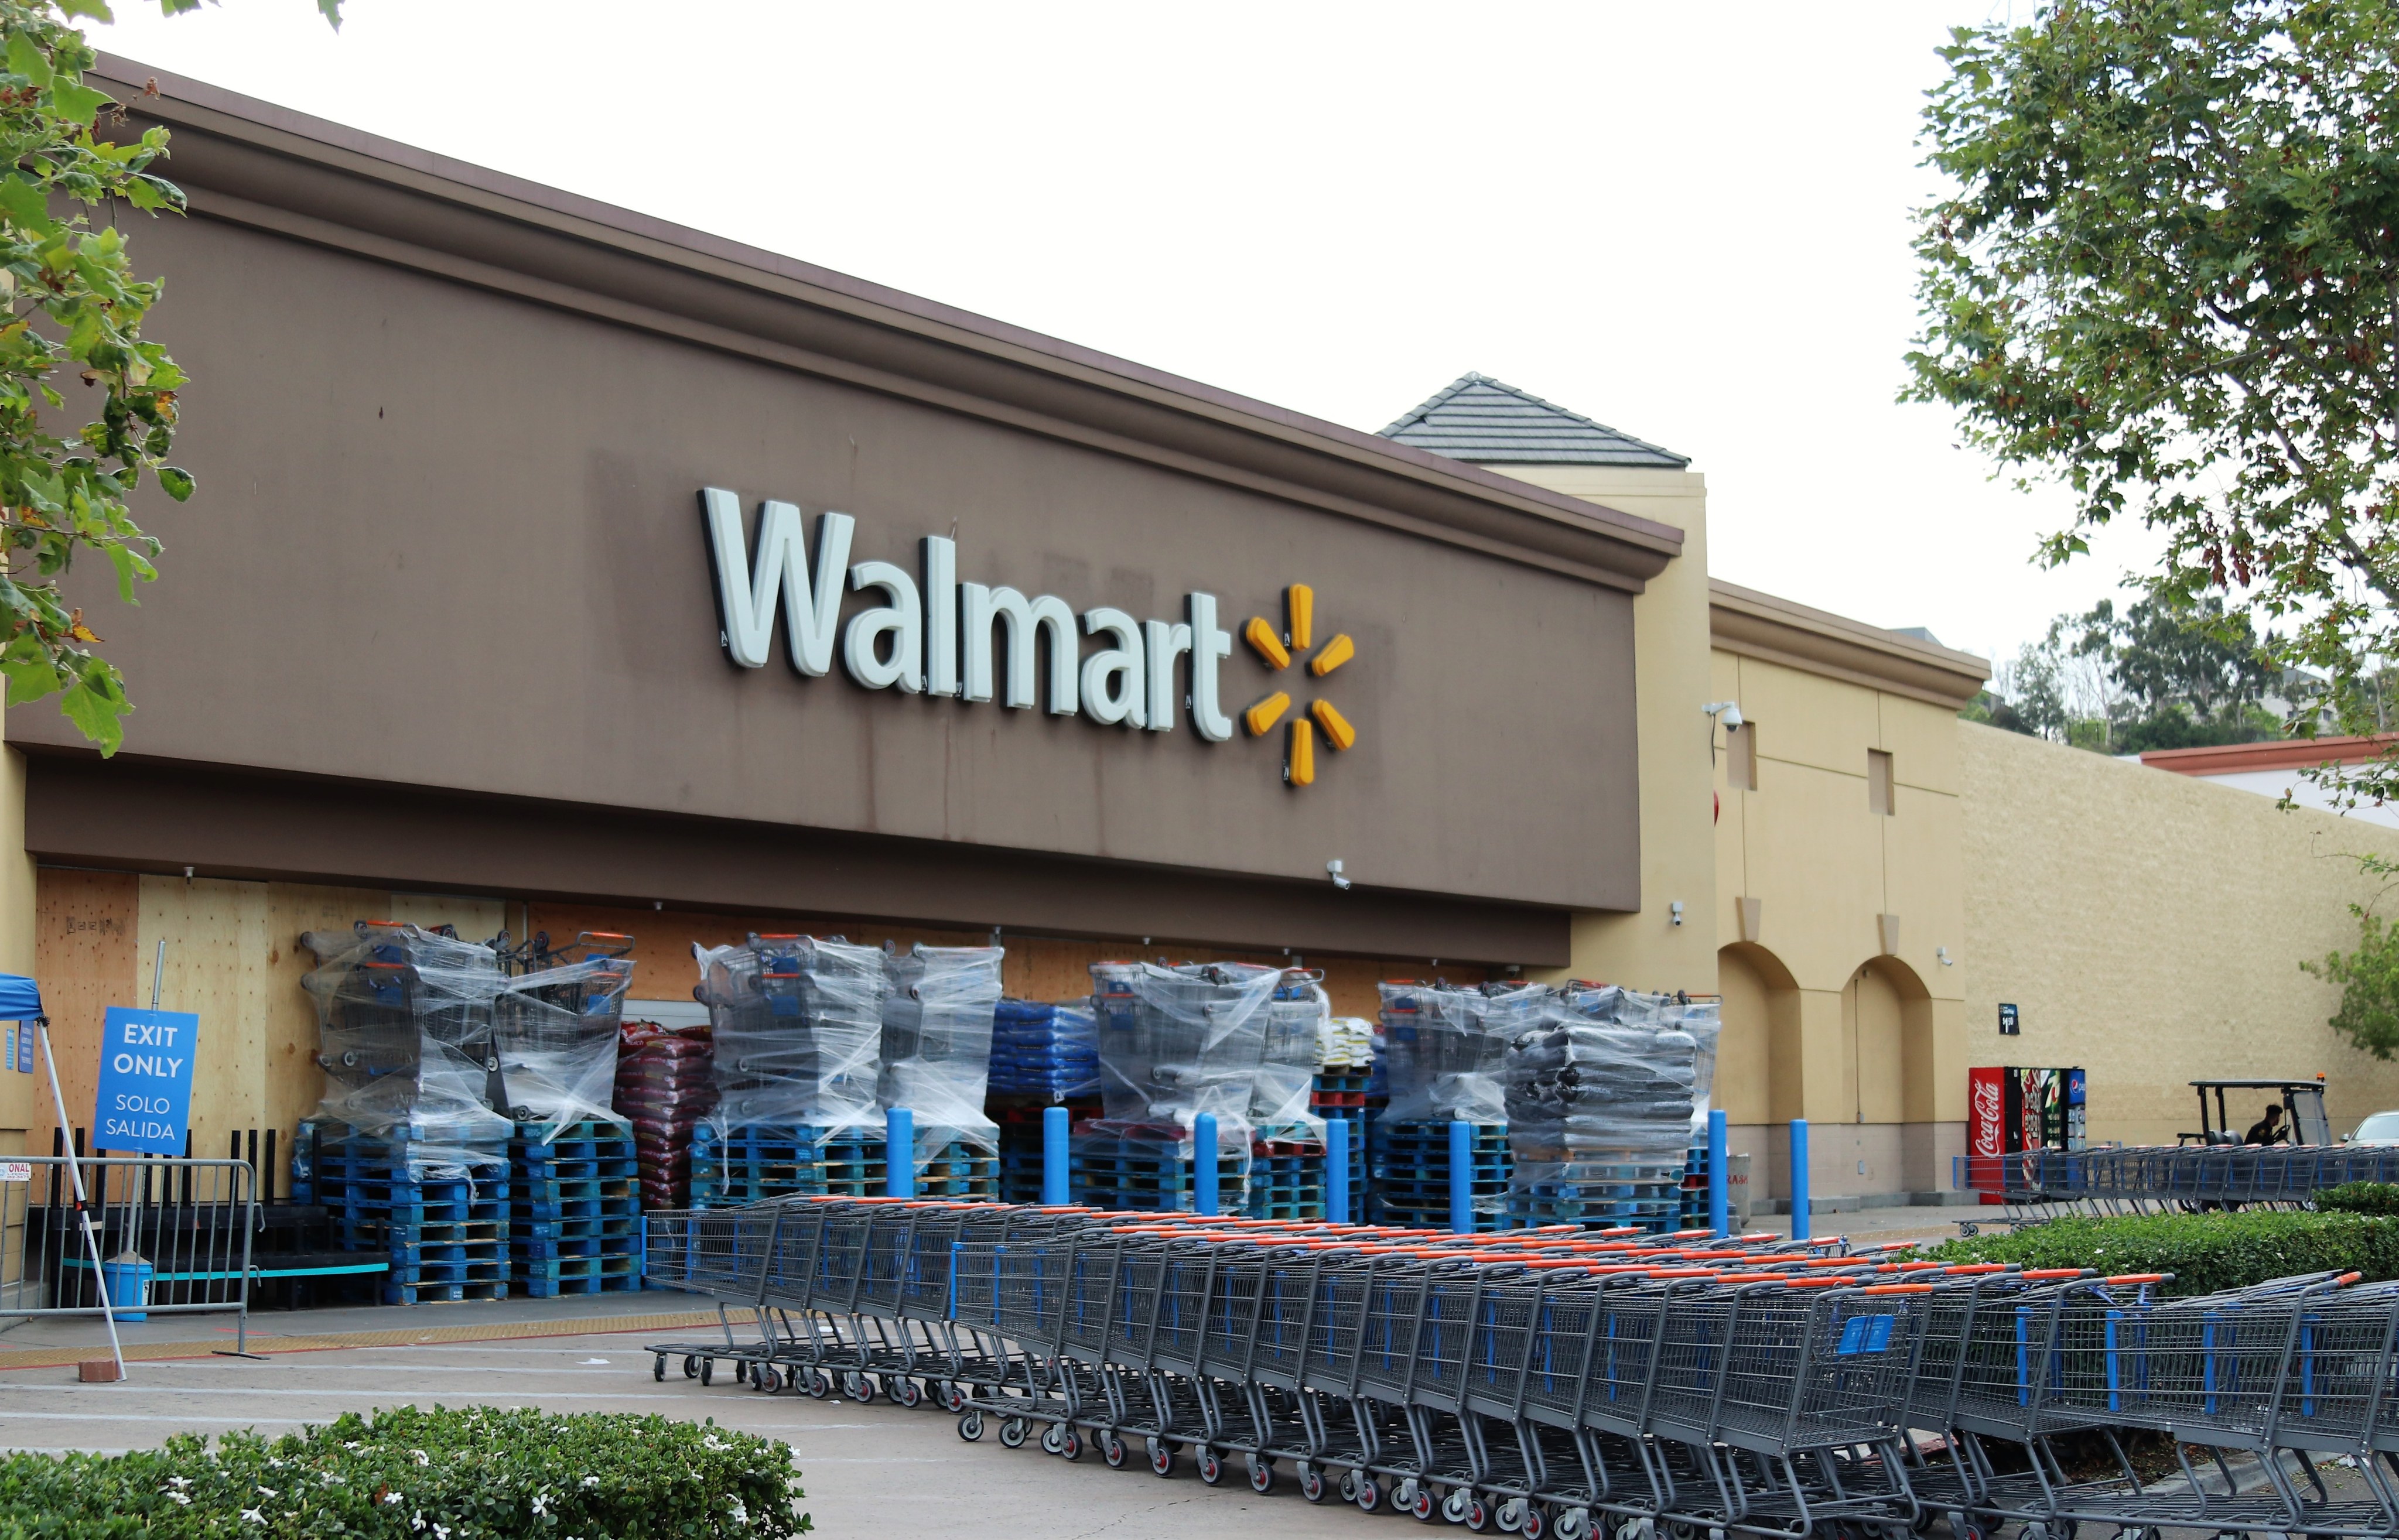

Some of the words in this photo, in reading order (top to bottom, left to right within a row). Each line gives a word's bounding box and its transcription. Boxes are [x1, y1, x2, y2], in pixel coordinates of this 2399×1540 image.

[696, 487, 1232, 742] Walmart
[124, 1024, 177, 1047] EXIT
[114, 1053, 183, 1077] ONLY
[116, 1094, 170, 1114] SOLO
[106, 1119, 175, 1140] SALIDA
[1974, 1078, 1999, 1158] Coca-Cola
[1726, 1175, 1748, 1185] RASH
